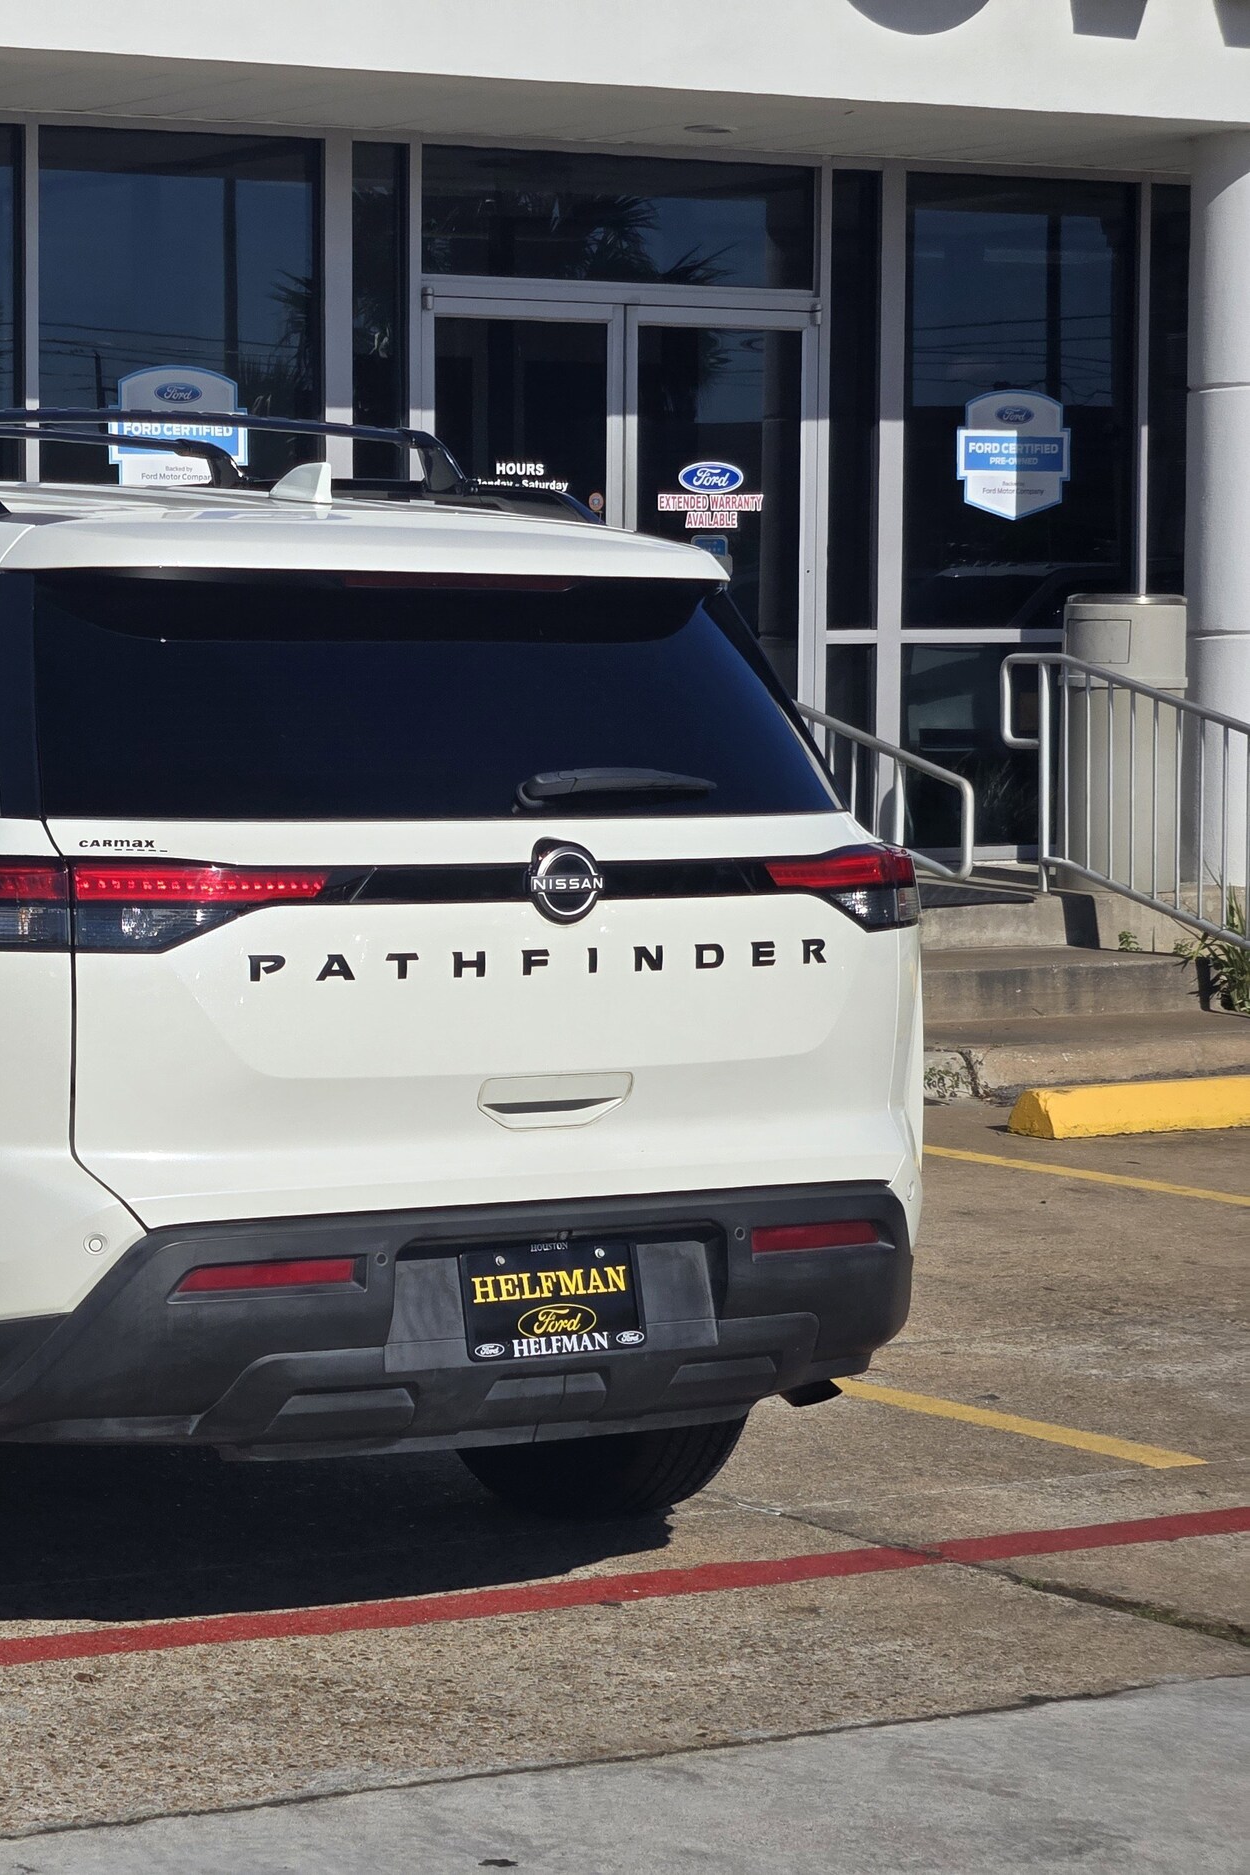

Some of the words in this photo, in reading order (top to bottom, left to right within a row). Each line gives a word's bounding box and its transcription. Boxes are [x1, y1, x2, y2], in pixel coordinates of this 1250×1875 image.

[163, 385, 192, 400] Ford
[1002, 407, 1026, 421] Ford
[123, 422, 161, 436] FORD
[163, 423, 233, 437] CERTIFIED
[968, 442, 1000, 454] FORD
[1001, 442, 1059, 455] CERTIFIED
[495, 462, 545, 476] HOURS
[159, 473, 181, 481] Motor
[692, 467, 730, 487] Ford
[521, 479, 569, 492] Saturday
[658, 494, 709, 511] EXTENDED
[710, 494, 763, 511] WARRANTY
[685, 512, 737, 528] AVAILABLE
[533, 875, 604, 891] NISSAN
[249, 938, 827, 983] PATHFINDER
[530, 1241, 568, 1252] HOUSTON
[471, 1265, 626, 1304] HELFMAN
[533, 1308, 582, 1335] Ford
[479, 1344, 500, 1356] Ford
[512, 1331, 610, 1358] HELFMAN
[620, 1331, 640, 1344] Ford
